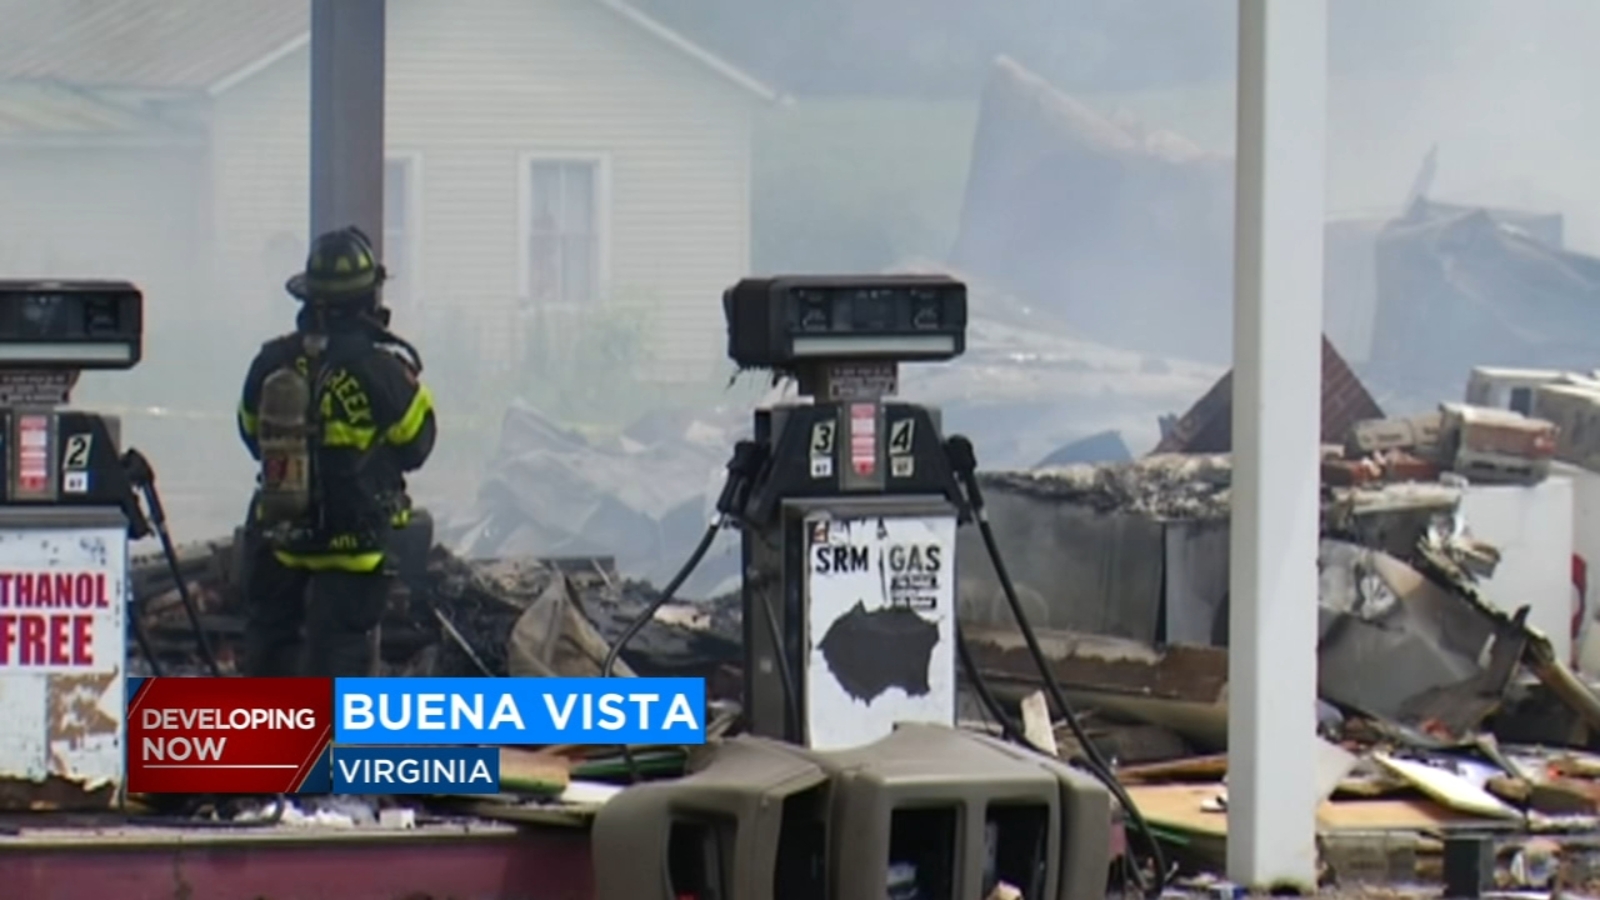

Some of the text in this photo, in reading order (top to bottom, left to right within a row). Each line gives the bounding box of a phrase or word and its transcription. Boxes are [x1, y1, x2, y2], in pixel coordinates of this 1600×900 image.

[814, 425, 831, 451] 3
[892, 422, 910, 450] 4
[67, 436, 87, 466] 2
[816, 545, 941, 574] SRM GAS
[0, 573, 109, 608] THANOL
[0, 614, 94, 666] FREE
